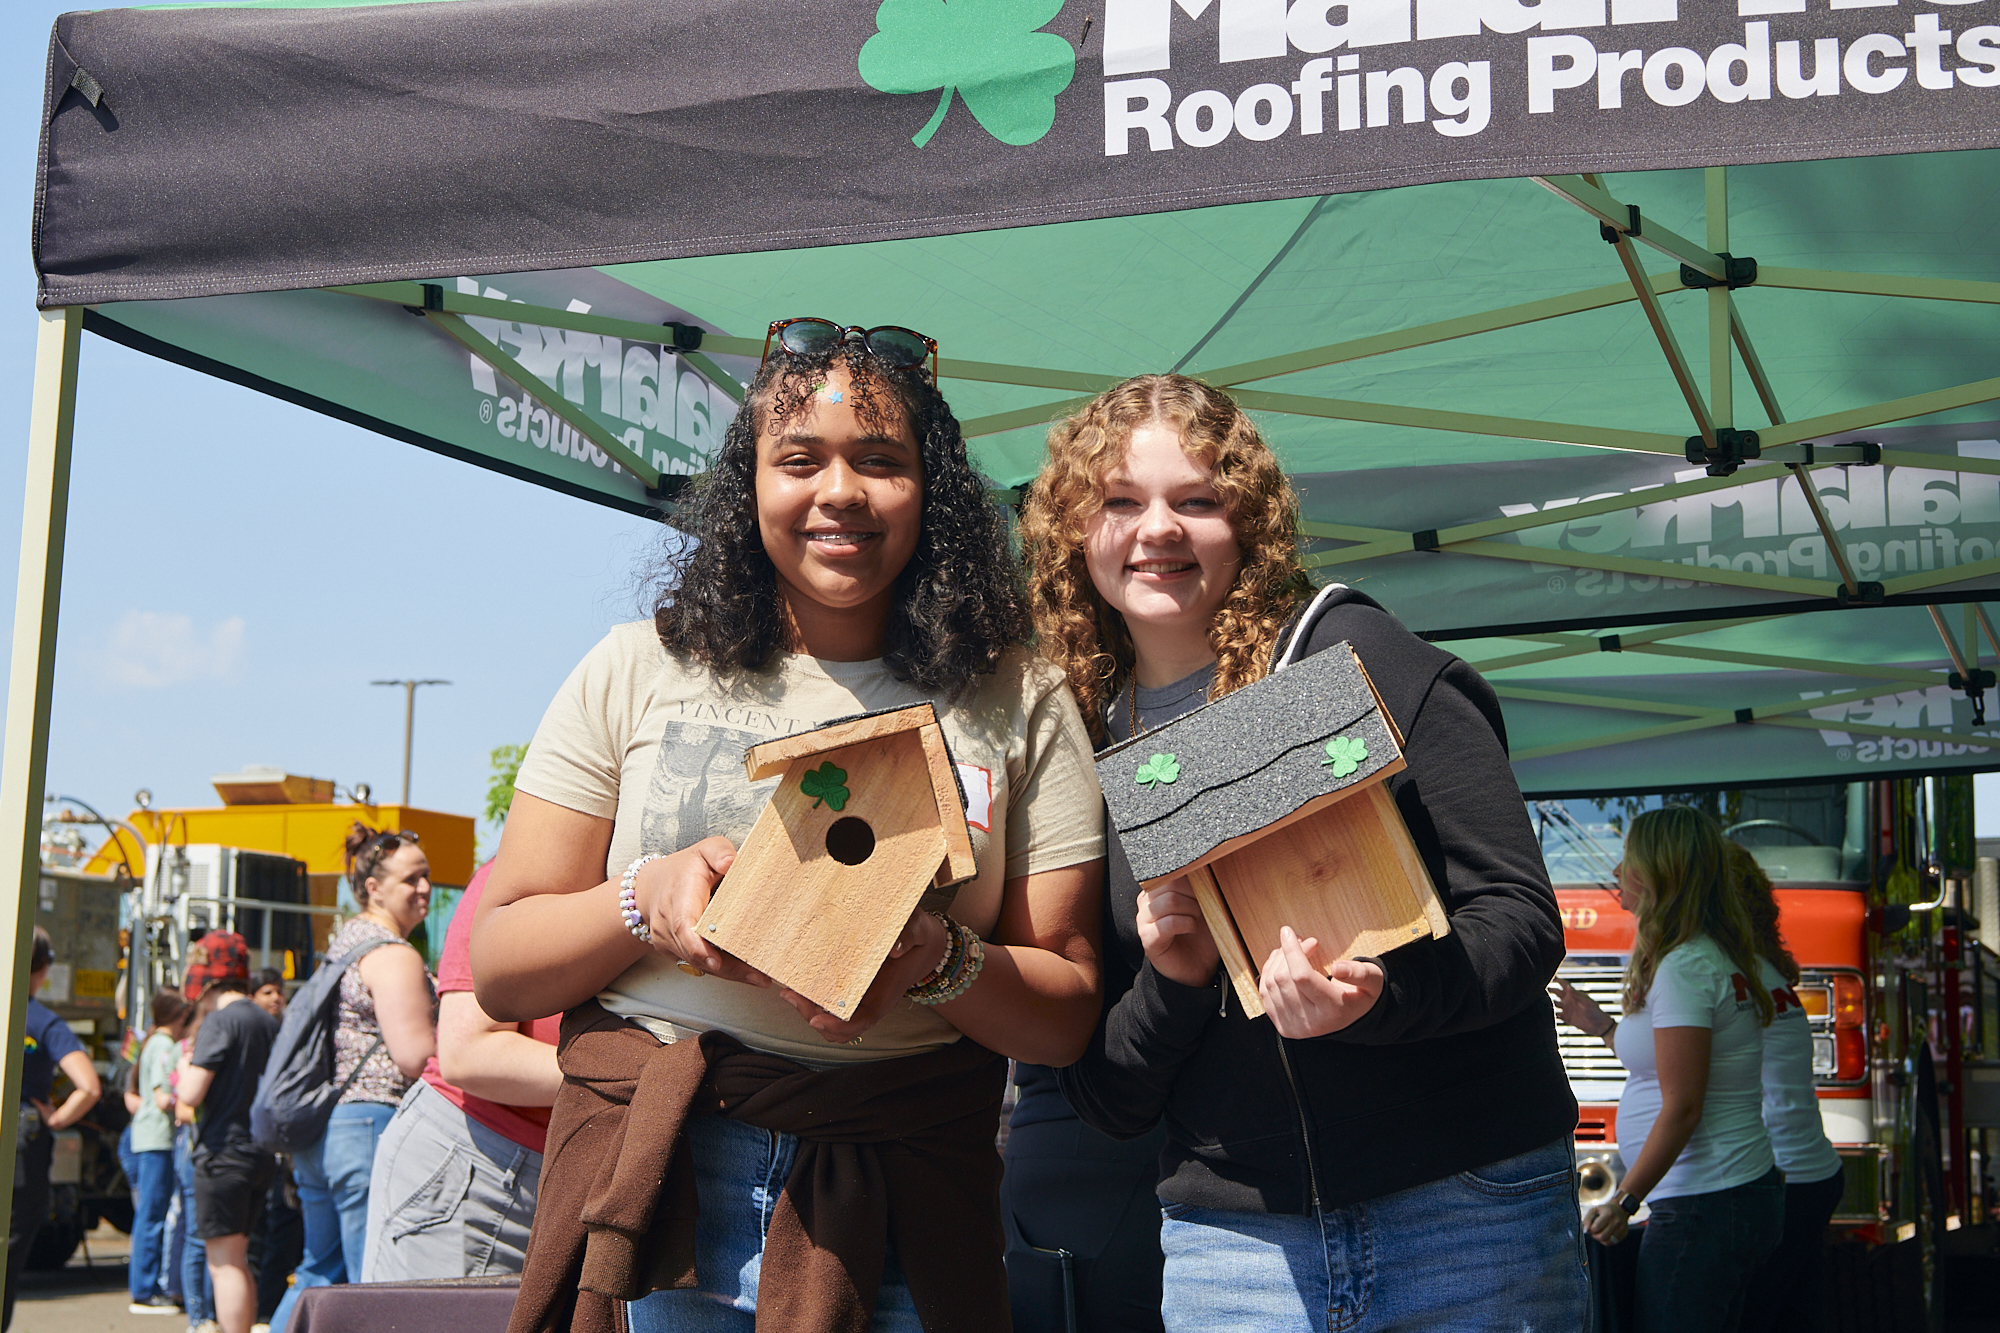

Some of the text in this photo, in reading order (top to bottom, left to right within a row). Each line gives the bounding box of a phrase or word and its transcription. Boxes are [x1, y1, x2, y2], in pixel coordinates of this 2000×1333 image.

[1103, 53, 1491, 156] Roofing
[1527, 13, 2000, 114] Products
[678, 700, 800, 734] VINCENT
